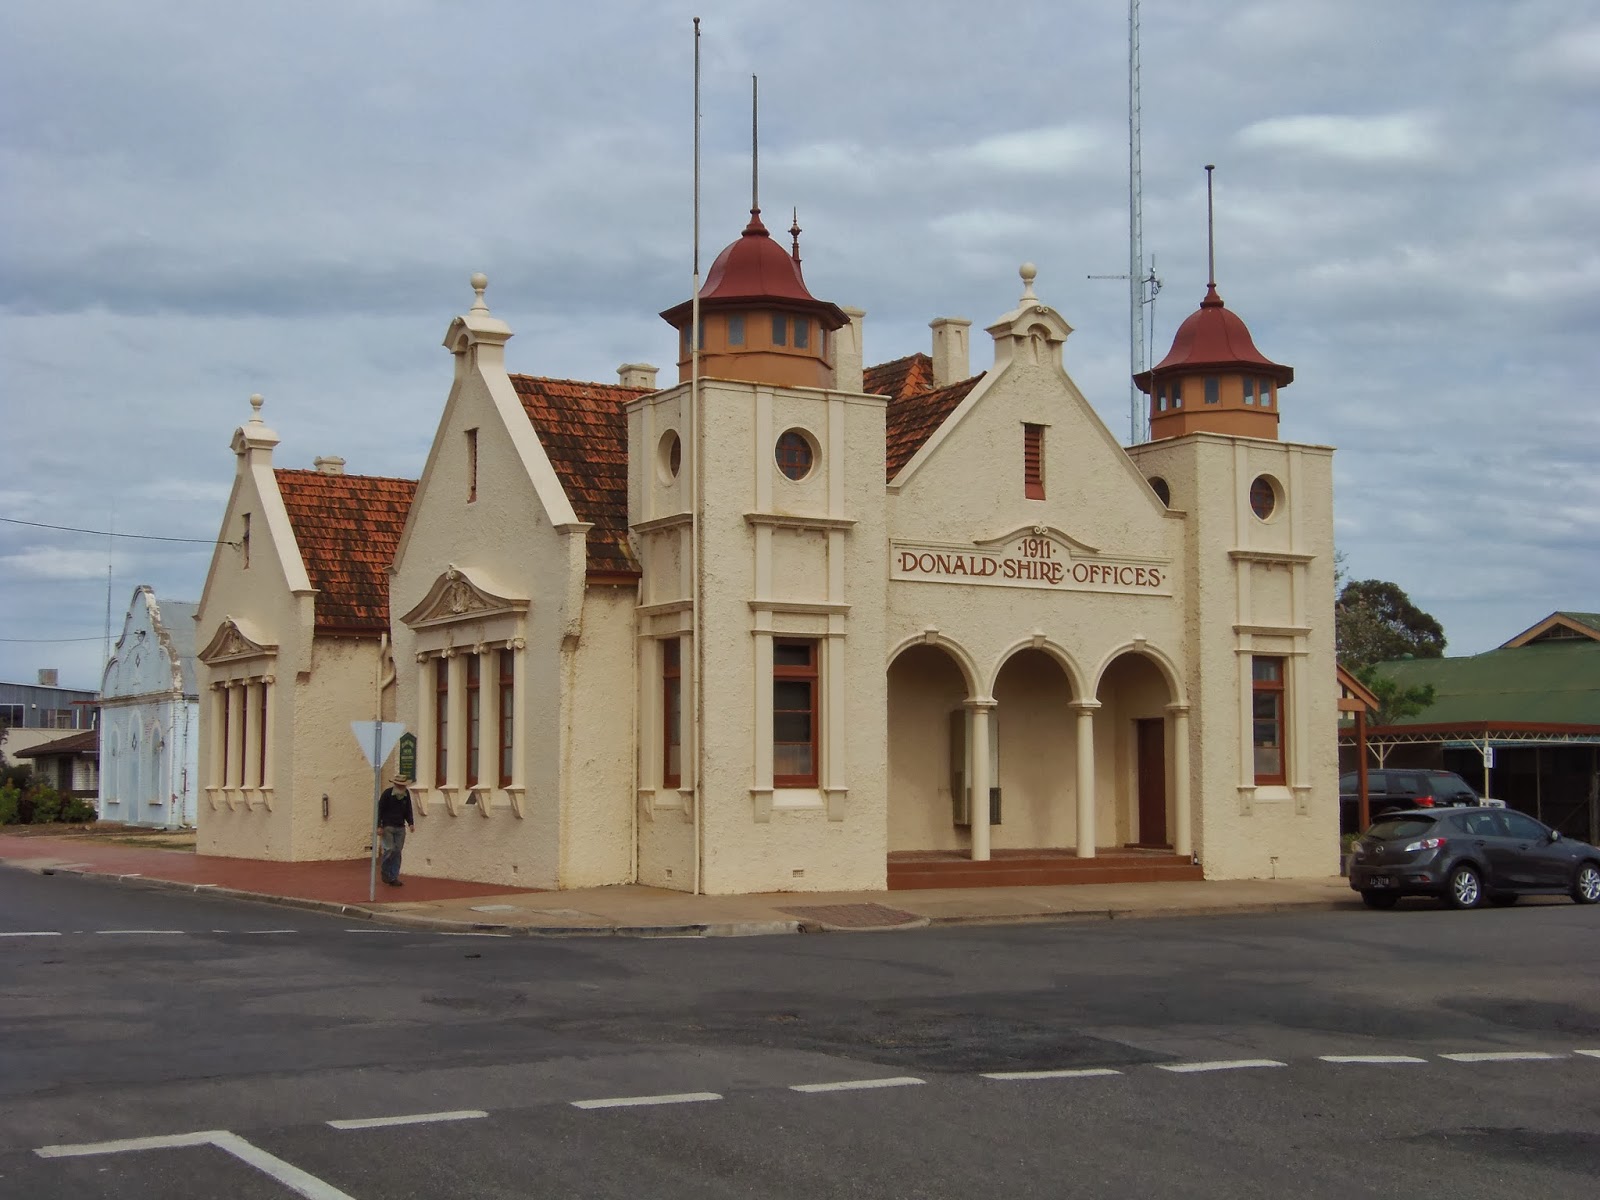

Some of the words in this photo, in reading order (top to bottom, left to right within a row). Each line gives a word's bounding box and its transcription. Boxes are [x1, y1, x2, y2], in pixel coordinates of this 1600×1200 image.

[1021, 538, 1051, 559] 1911
[901, 552, 997, 577] DONALD
[1003, 558, 1064, 584] SHIRE
[1073, 563, 1161, 587] OFFICES
